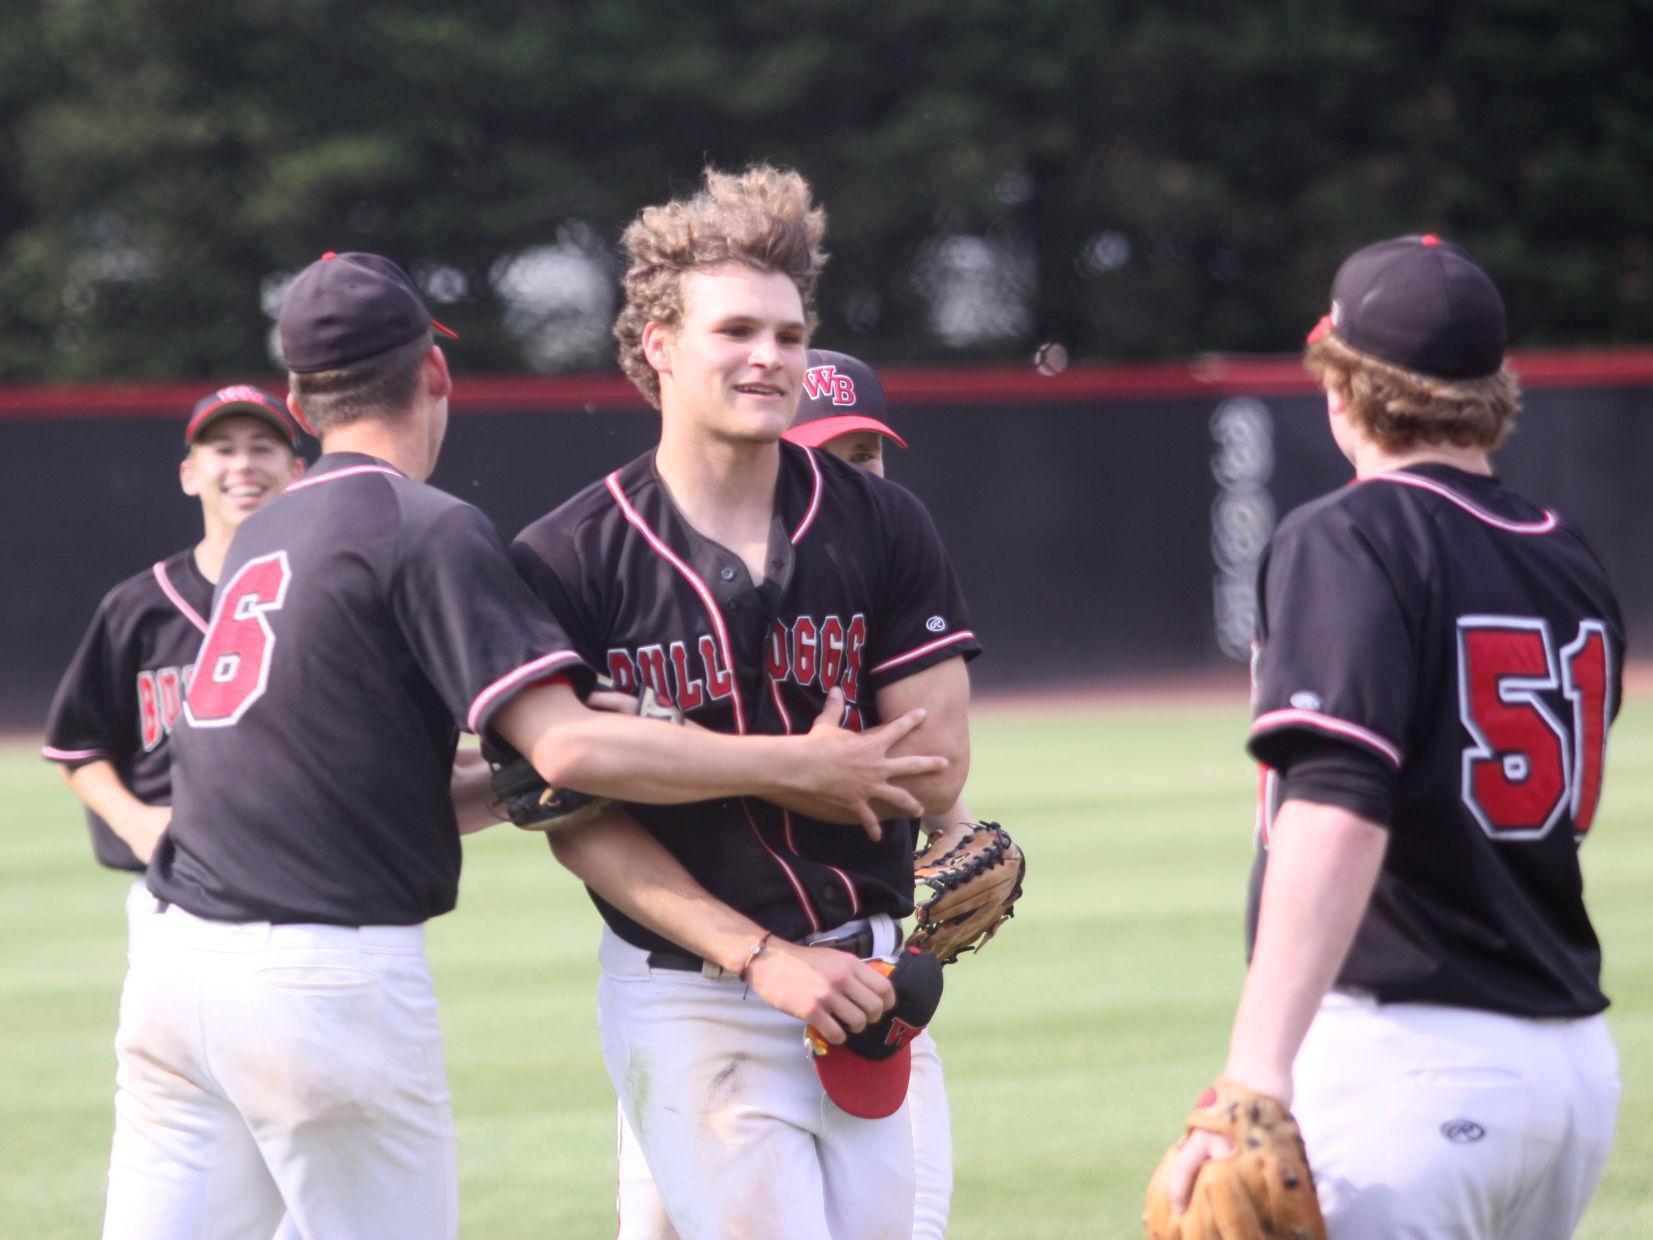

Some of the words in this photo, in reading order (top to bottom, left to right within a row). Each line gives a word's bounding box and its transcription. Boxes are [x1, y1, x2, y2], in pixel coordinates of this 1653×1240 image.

[803, 365, 856, 406] WB
[183, 550, 291, 727] 6
[137, 664, 194, 752] BU
[1456, 615, 1609, 842] 51
